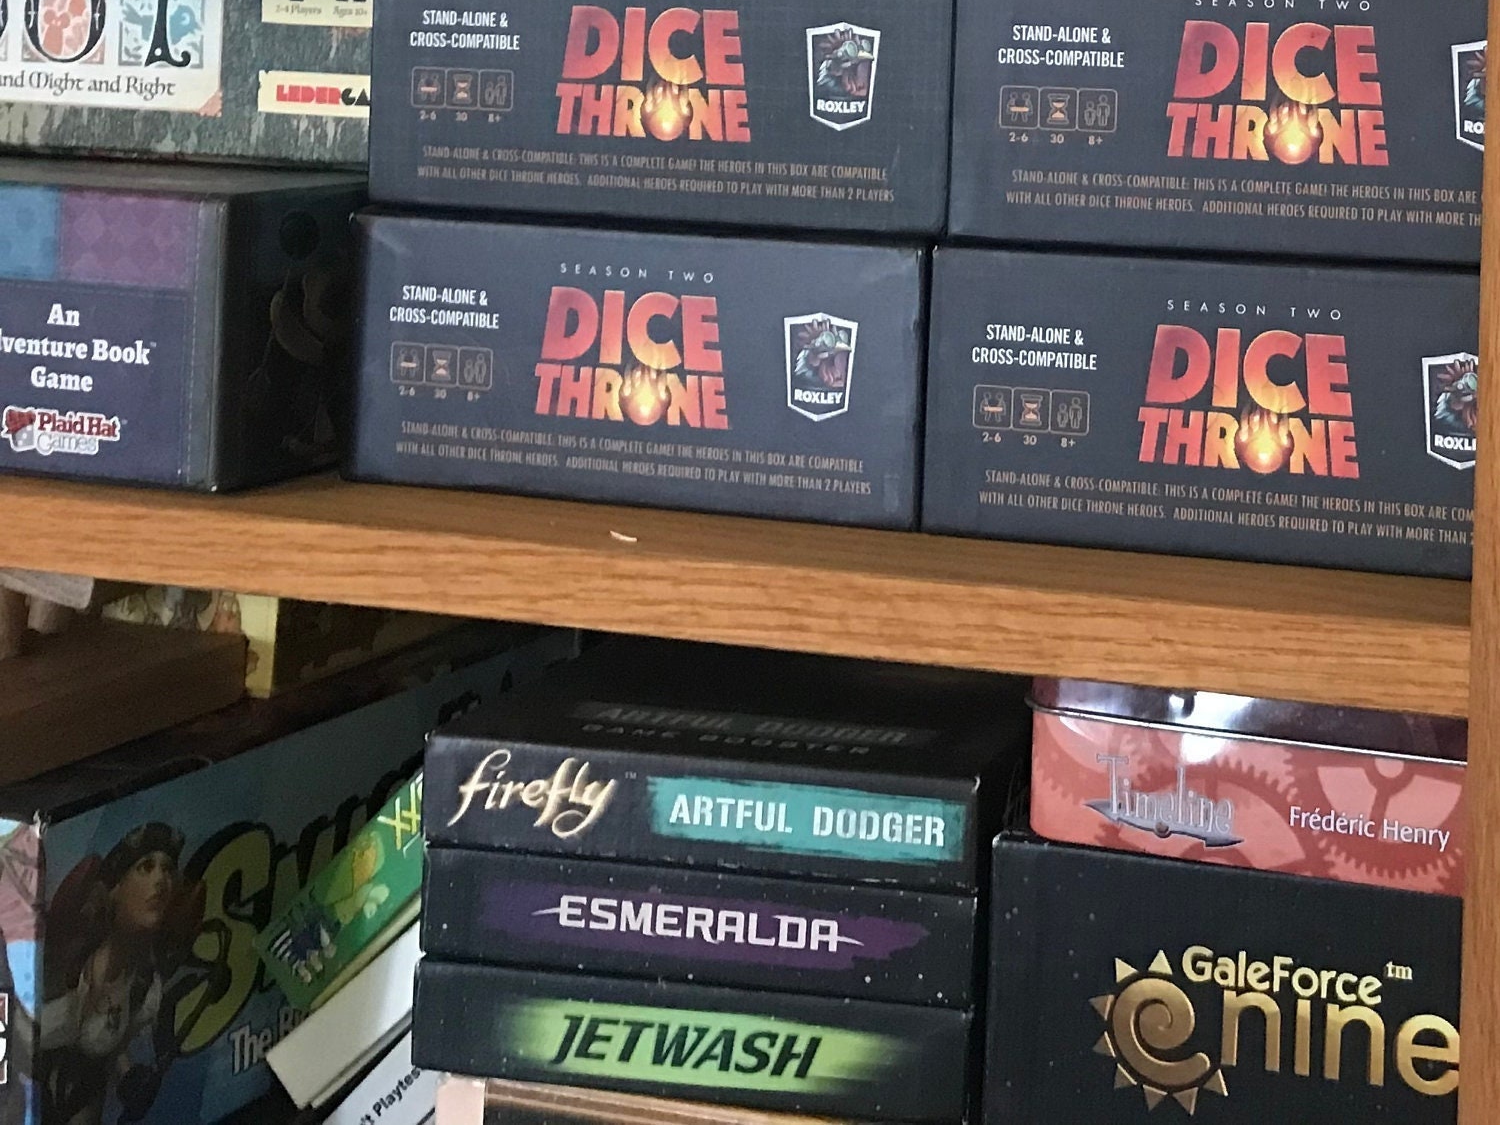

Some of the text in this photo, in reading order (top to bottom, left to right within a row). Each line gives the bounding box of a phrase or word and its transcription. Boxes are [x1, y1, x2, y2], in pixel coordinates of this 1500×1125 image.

[422, 10, 508, 28] STAND-ALONE &
[1012, 24, 1111, 45] STAND-ALONE &
[410, 31, 520, 50] CROSS-COMPATIBLE
[562, 5, 744, 86] DICE
[998, 48, 1125, 69] CROSS-COMPATIBLE
[1172, 20, 1382, 106] DICE
[29, 70, 83, 96] Might
[88, 75, 120, 94] and
[126, 76, 176, 101] Right
[555, 82, 752, 143] THRONE
[816, 99, 866, 115] ROXLEY
[1009, 131, 1029, 144] 2-6
[1088, 134, 1103, 146] 8+
[1165, 102, 1390, 167] THRONE
[560, 263, 715, 284] SEASON TWO
[402, 285, 488, 307] STAND-ALONE &
[1167, 299, 1342, 321] SEASON TWO
[47, 303, 80, 327] An
[389, 306, 500, 330] CROSS-COMPATIBLE
[540, 286, 724, 373] DICE
[985, 324, 1084, 346] STAND-ALONE &
[91, 339, 151, 365] Book
[971, 347, 1098, 372] CROSS-COMPATIBLE
[30, 366, 93, 392] Game
[1144, 324, 1352, 417] DICE
[534, 362, 730, 430] THRONE
[794, 389, 843, 405] ROXLEY
[37, 412, 118, 437] Plaid Hat
[981, 431, 1002, 444] 2-6
[1060, 436, 1076, 448] 8+
[37, 432, 97, 453] Games
[1137, 406, 1360, 480] THRONE
[985, 469, 1051, 488] STAND-ALONE
[1054, 476, 1061, 488] &
[1165, 484, 1186, 498] THIS
[1189, 486, 1198, 499] IS
[1202, 487, 1209, 500] A
[1211, 487, 1262, 505] COMPLETE
[1265, 492, 1297, 508] GAME!
[1302, 495, 1319, 509] THE
[1322, 497, 1360, 513] HEROES
[1364, 500, 1375, 514] IN
[1379, 501, 1401, 516] THIS
[1404, 504, 1424, 518] BOX
[1428, 506, 1447, 520] ARE
[979, 491, 1004, 505] WITH
[1007, 493, 1024, 507] ALL
[1028, 494, 1058, 509] OTHER
[1061, 498, 1082, 512] DICE
[1087, 499, 1124, 516] THRONE
[1173, 507, 1233, 524] ADDITIONAL
[1238, 513, 1275, 528] HEROES
[1279, 516, 1328, 532] REQUIRED
[1332, 520, 1344, 533] TO
[1348, 521, 1372, 536] PLAY
[1376, 524, 1401, 538] WITH
[1406, 526, 1434, 542] MORE
[1439, 529, 1467, 544] THAN
[447, 748, 618, 839] firefly
[1096, 753, 1236, 835] Timeline
[669, 794, 946, 848] ARTFUL DODGER
[1290, 806, 1451, 852] Frédéric Henry
[531, 894, 864, 953] ESMERALDA
[1182, 945, 1382, 1006] GaleForce
[229, 1018, 272, 1075] The
[551, 1014, 824, 1079] JETWASH
[1221, 990, 1460, 1096] nine
